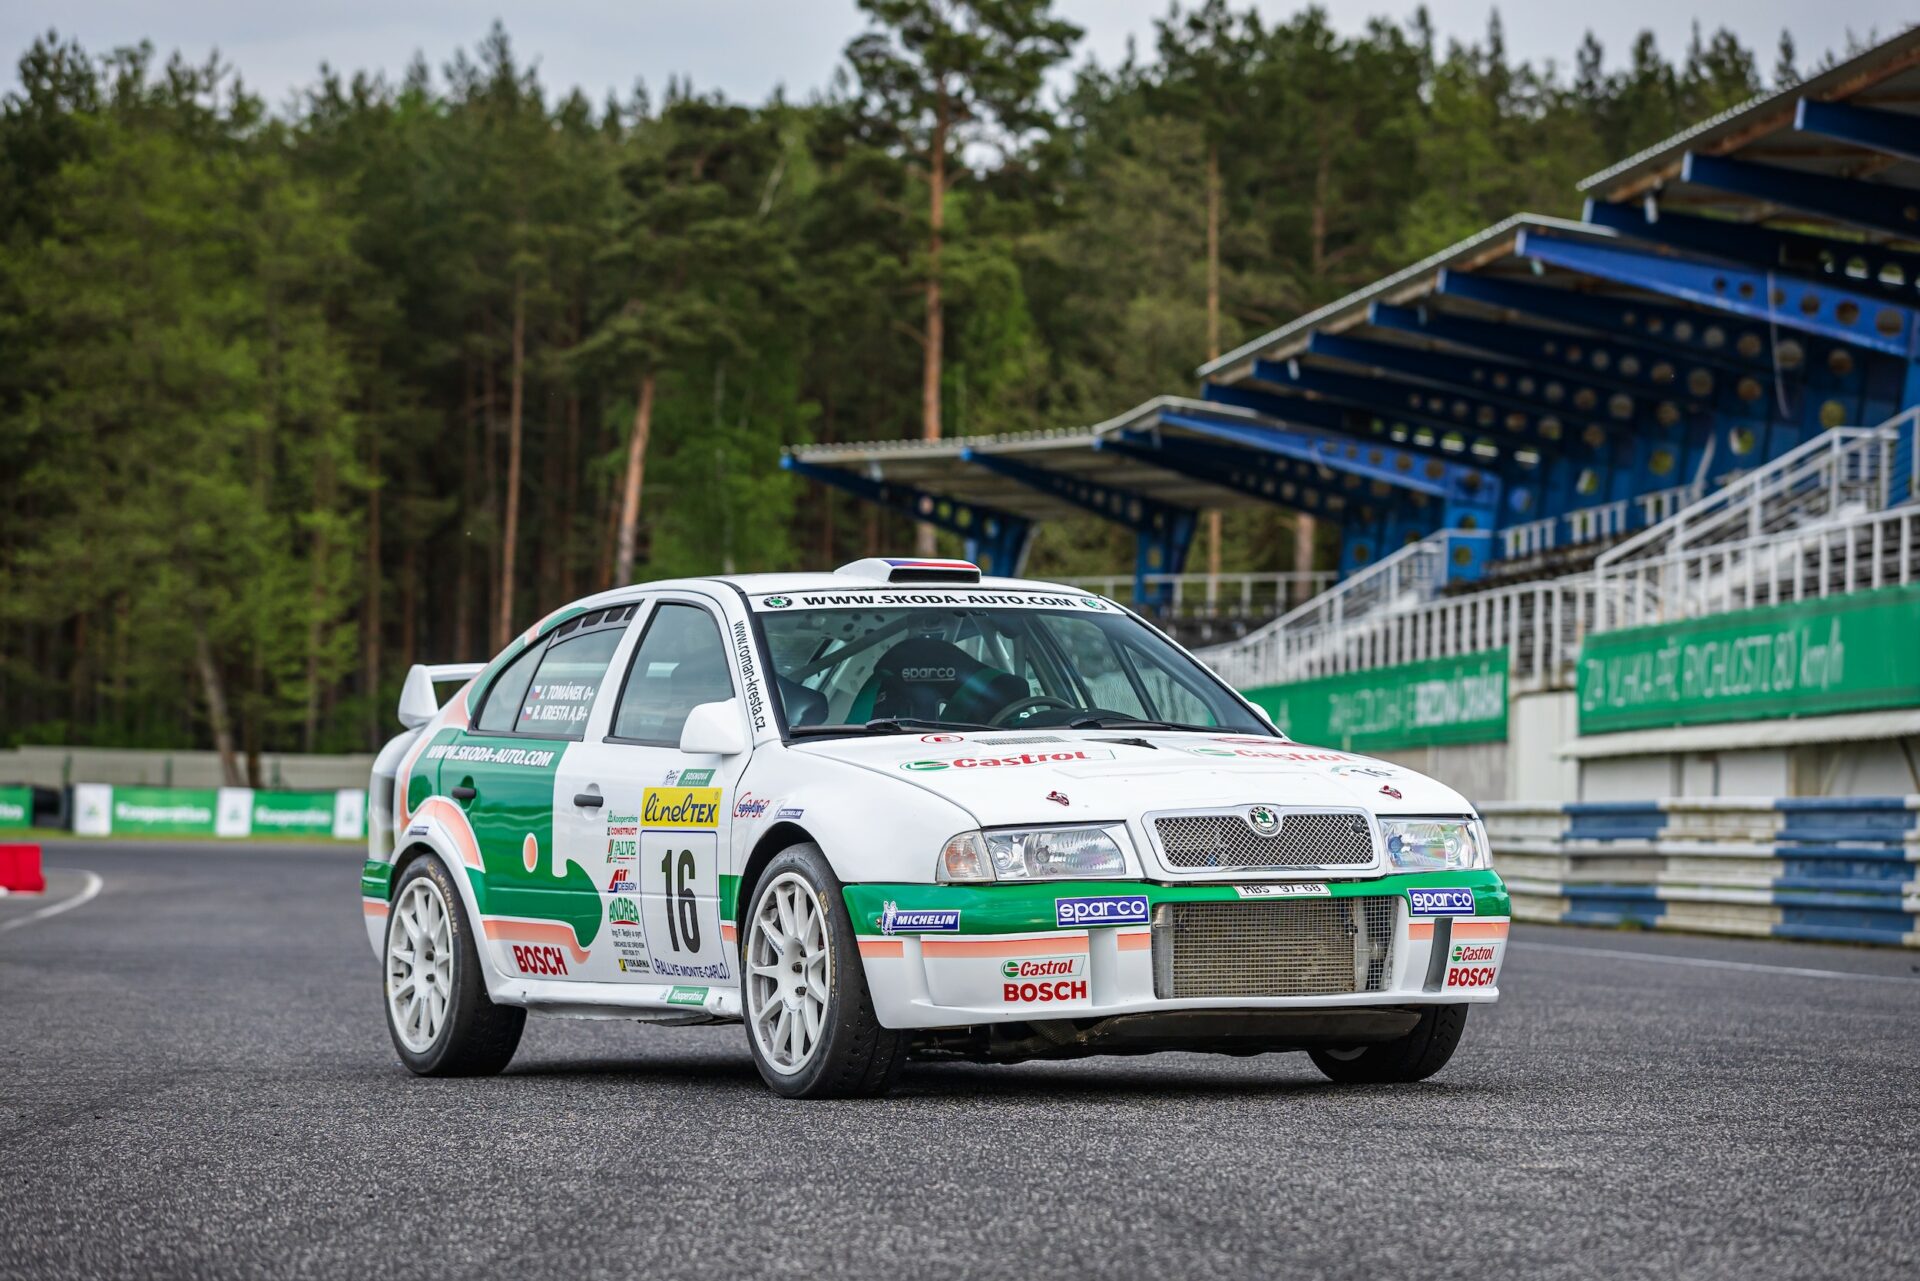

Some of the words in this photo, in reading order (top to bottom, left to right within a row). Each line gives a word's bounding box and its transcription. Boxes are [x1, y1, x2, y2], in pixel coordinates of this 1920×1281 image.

[802, 594, 1077, 608] WWW.SKODA-AUTO.COM
[734, 620, 766, 732] www.roman-kresta.cz
[901, 666, 956, 680] sparco
[547, 681, 585, 700] TOMÁNEK
[540, 704, 570, 720] KRESTA
[426, 745, 555, 767] WWW.SKODA-AUTO.COM
[953, 751, 1091, 768] Castrol
[610, 827, 638, 836] CONSTRUCT
[609, 897, 640, 922] ANDREA
[661, 850, 701, 954] 16
[1059, 899, 1146, 923] sparco
[1412, 891, 1473, 912] sparco
[896, 914, 957, 926] MICHELIN
[513, 945, 569, 976] BOSCH
[1461, 944, 1494, 962] Castrol
[655, 959, 681, 976] RALLYE
[680, 963, 727, 980] MONTE-CARLO
[1020, 958, 1073, 978] Castrol
[1448, 967, 1497, 987] BOSCH
[1003, 981, 1088, 1002] BOSCH
